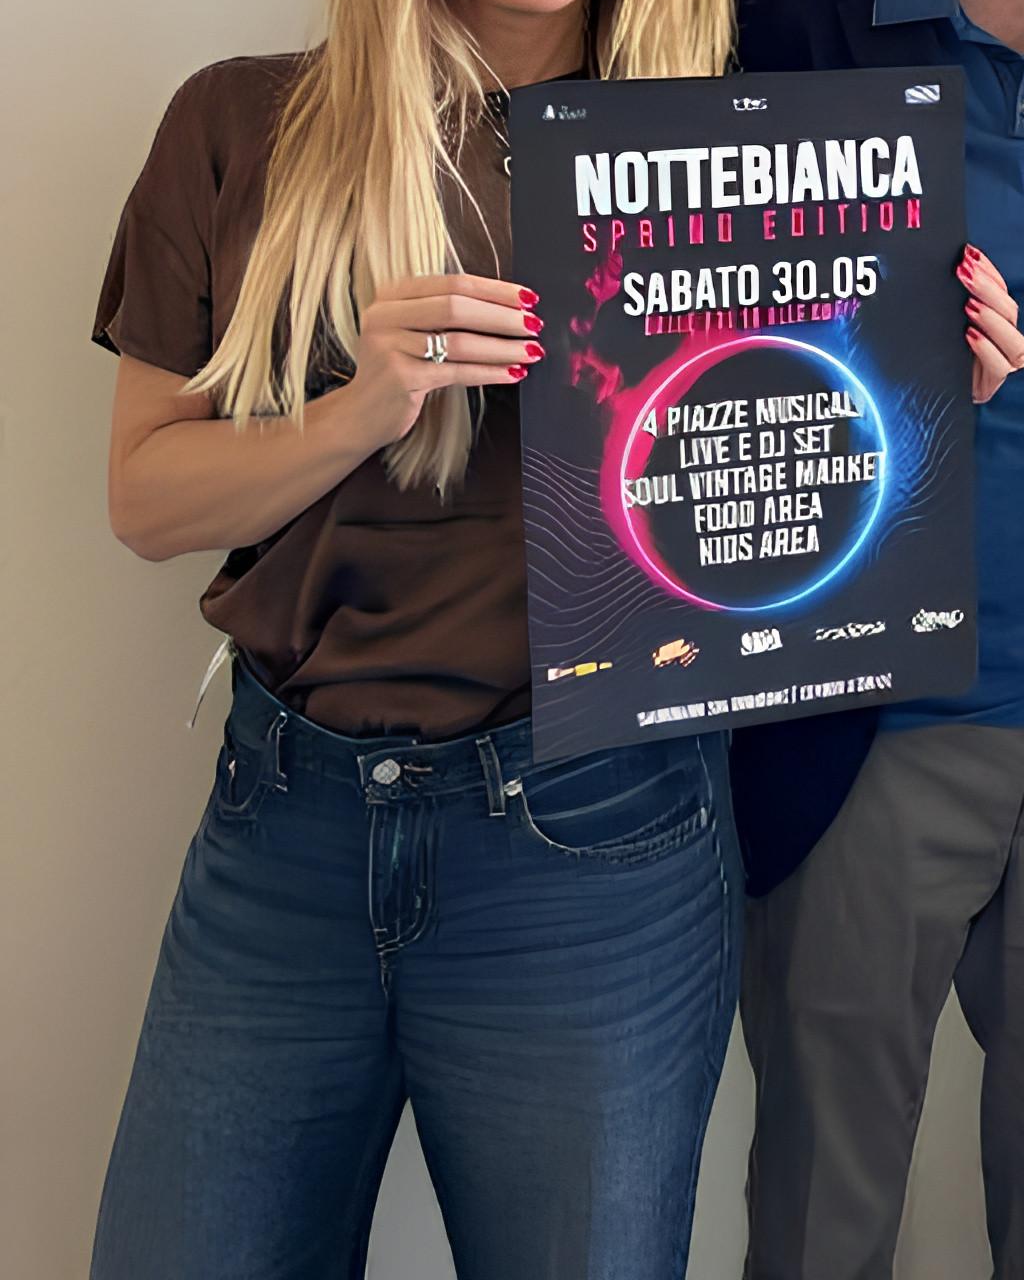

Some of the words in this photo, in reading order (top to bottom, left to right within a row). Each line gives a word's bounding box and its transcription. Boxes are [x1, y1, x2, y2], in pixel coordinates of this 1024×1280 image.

[574, 135, 923, 217] NOTTEBIANCA
[622, 263, 760, 318] SABATO
[771, 255, 878, 304] 30.05
[667, 398, 749, 436] PIAZZE
[679, 434, 731, 470] LIVE
[738, 433, 752, 461] E
[759, 430, 786, 459] DJ
[793, 424, 835, 456] SET
[622, 473, 684, 508] SOUL
[689, 461, 787, 501] VINTAGE
[795, 450, 887, 488] MARKET
[694, 501, 756, 533] FOOD
[763, 491, 824, 526] AREA
[699, 532, 753, 567] KIDS
[759, 525, 820, 559] AREA
